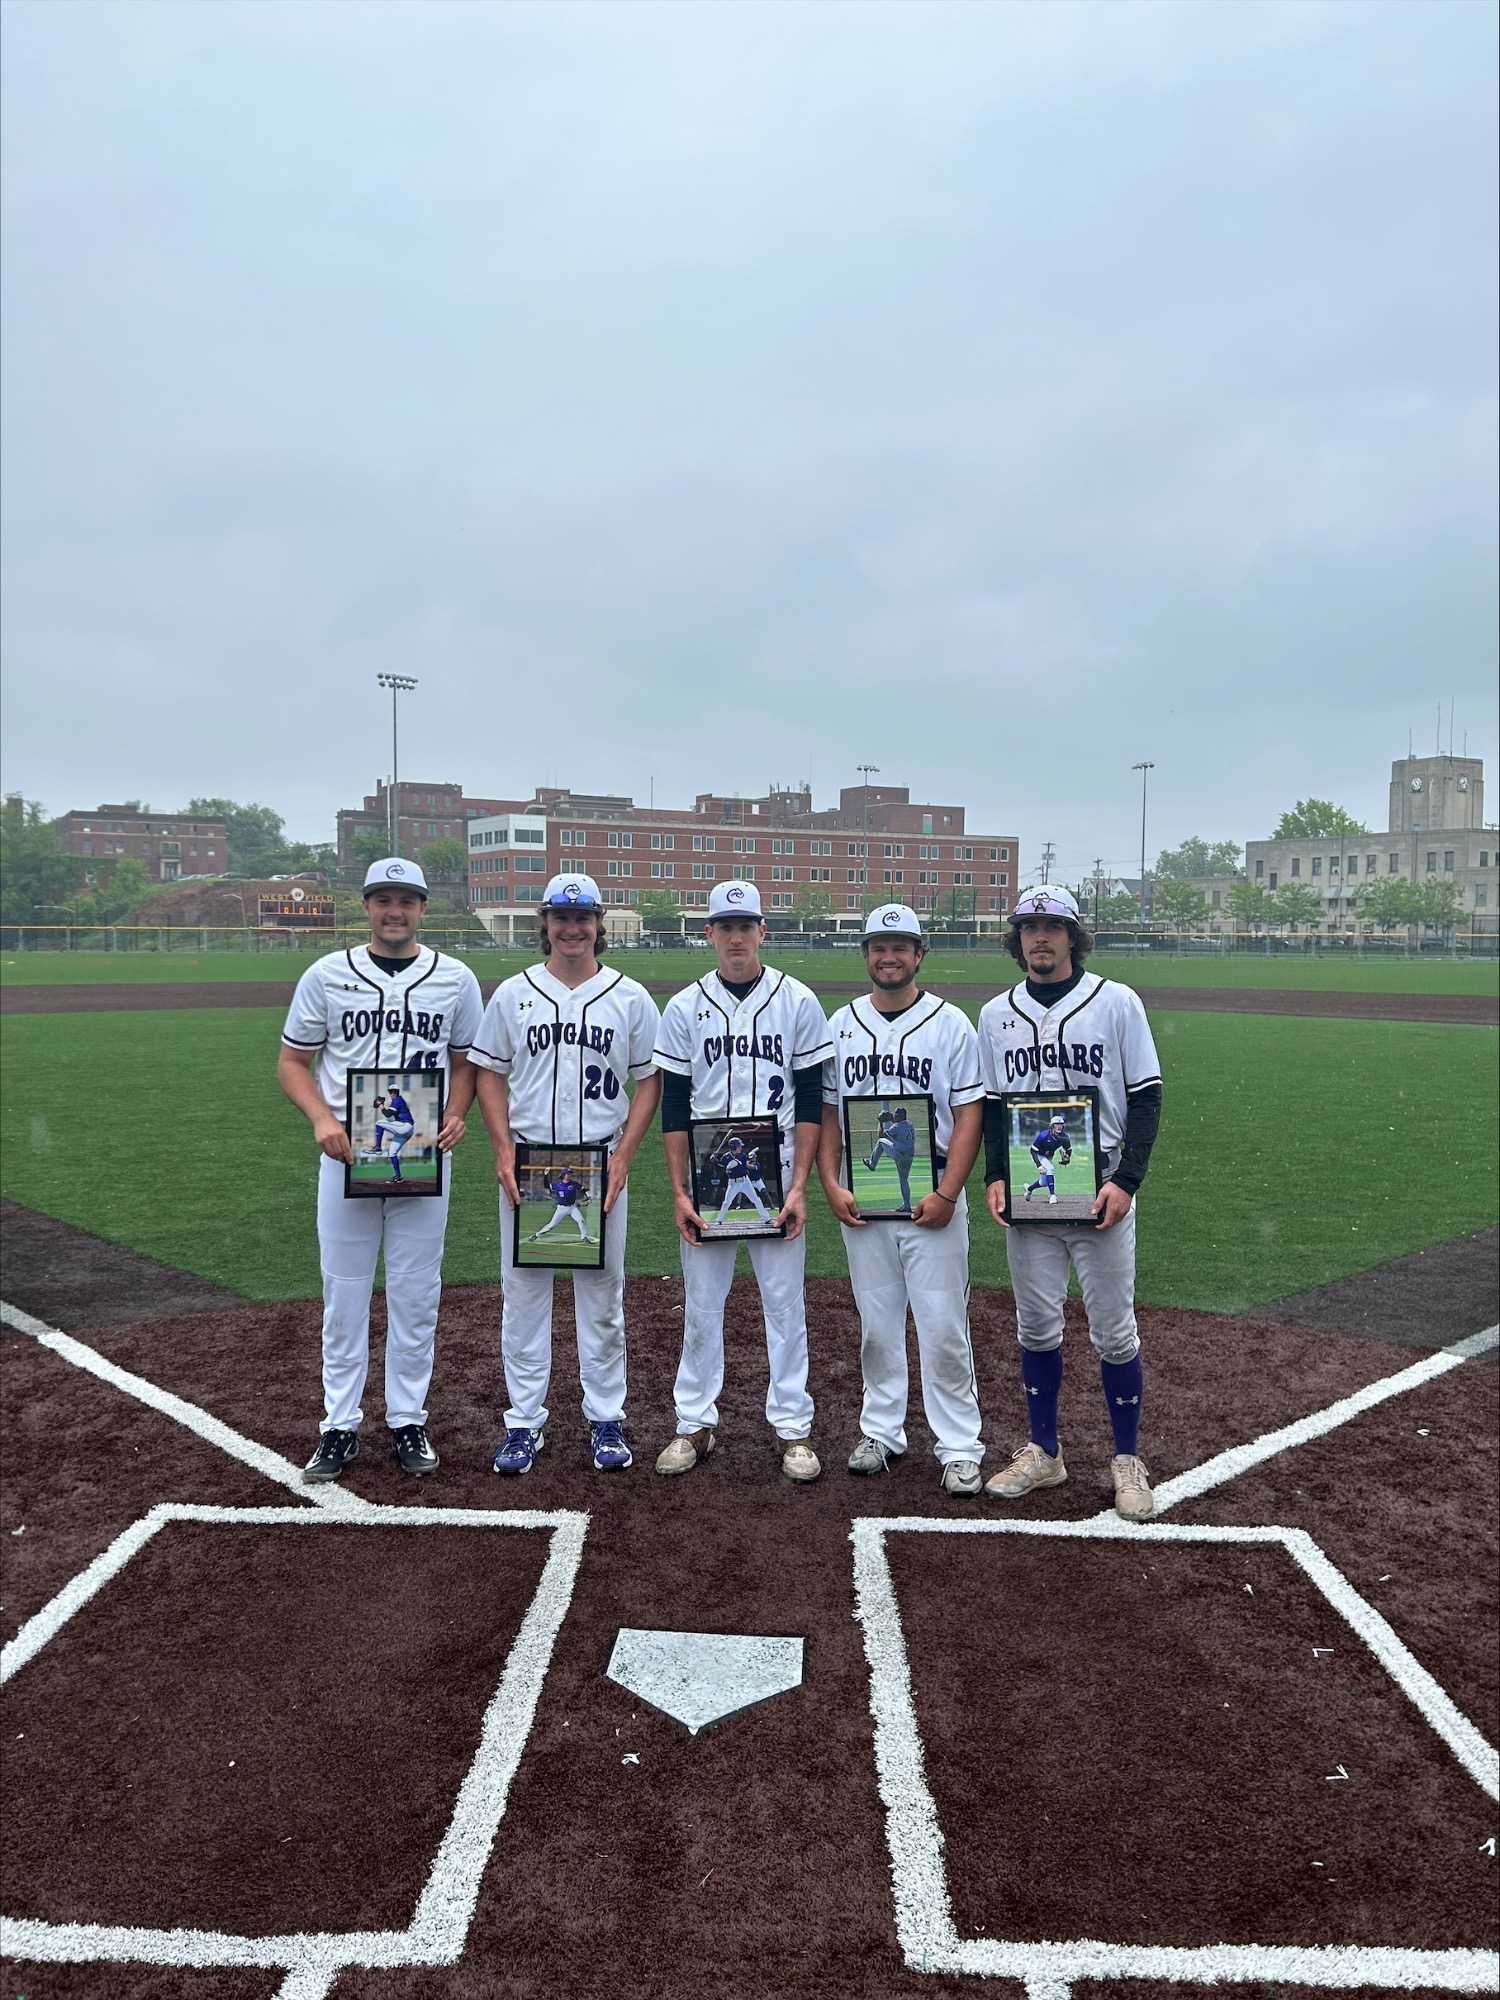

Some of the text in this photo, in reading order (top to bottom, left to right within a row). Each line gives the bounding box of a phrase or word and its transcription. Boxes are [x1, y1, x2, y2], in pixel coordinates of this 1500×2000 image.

[341, 1009, 444, 1044] COUGARS
[526, 1022, 615, 1057] COUGARS
[703, 1033, 784, 1068] COUGARS
[1004, 1044, 1104, 1084] COUGARS
[584, 1064, 620, 1101] 20
[844, 1053, 933, 1091] COUGARS
[767, 1075, 785, 1111] 2
